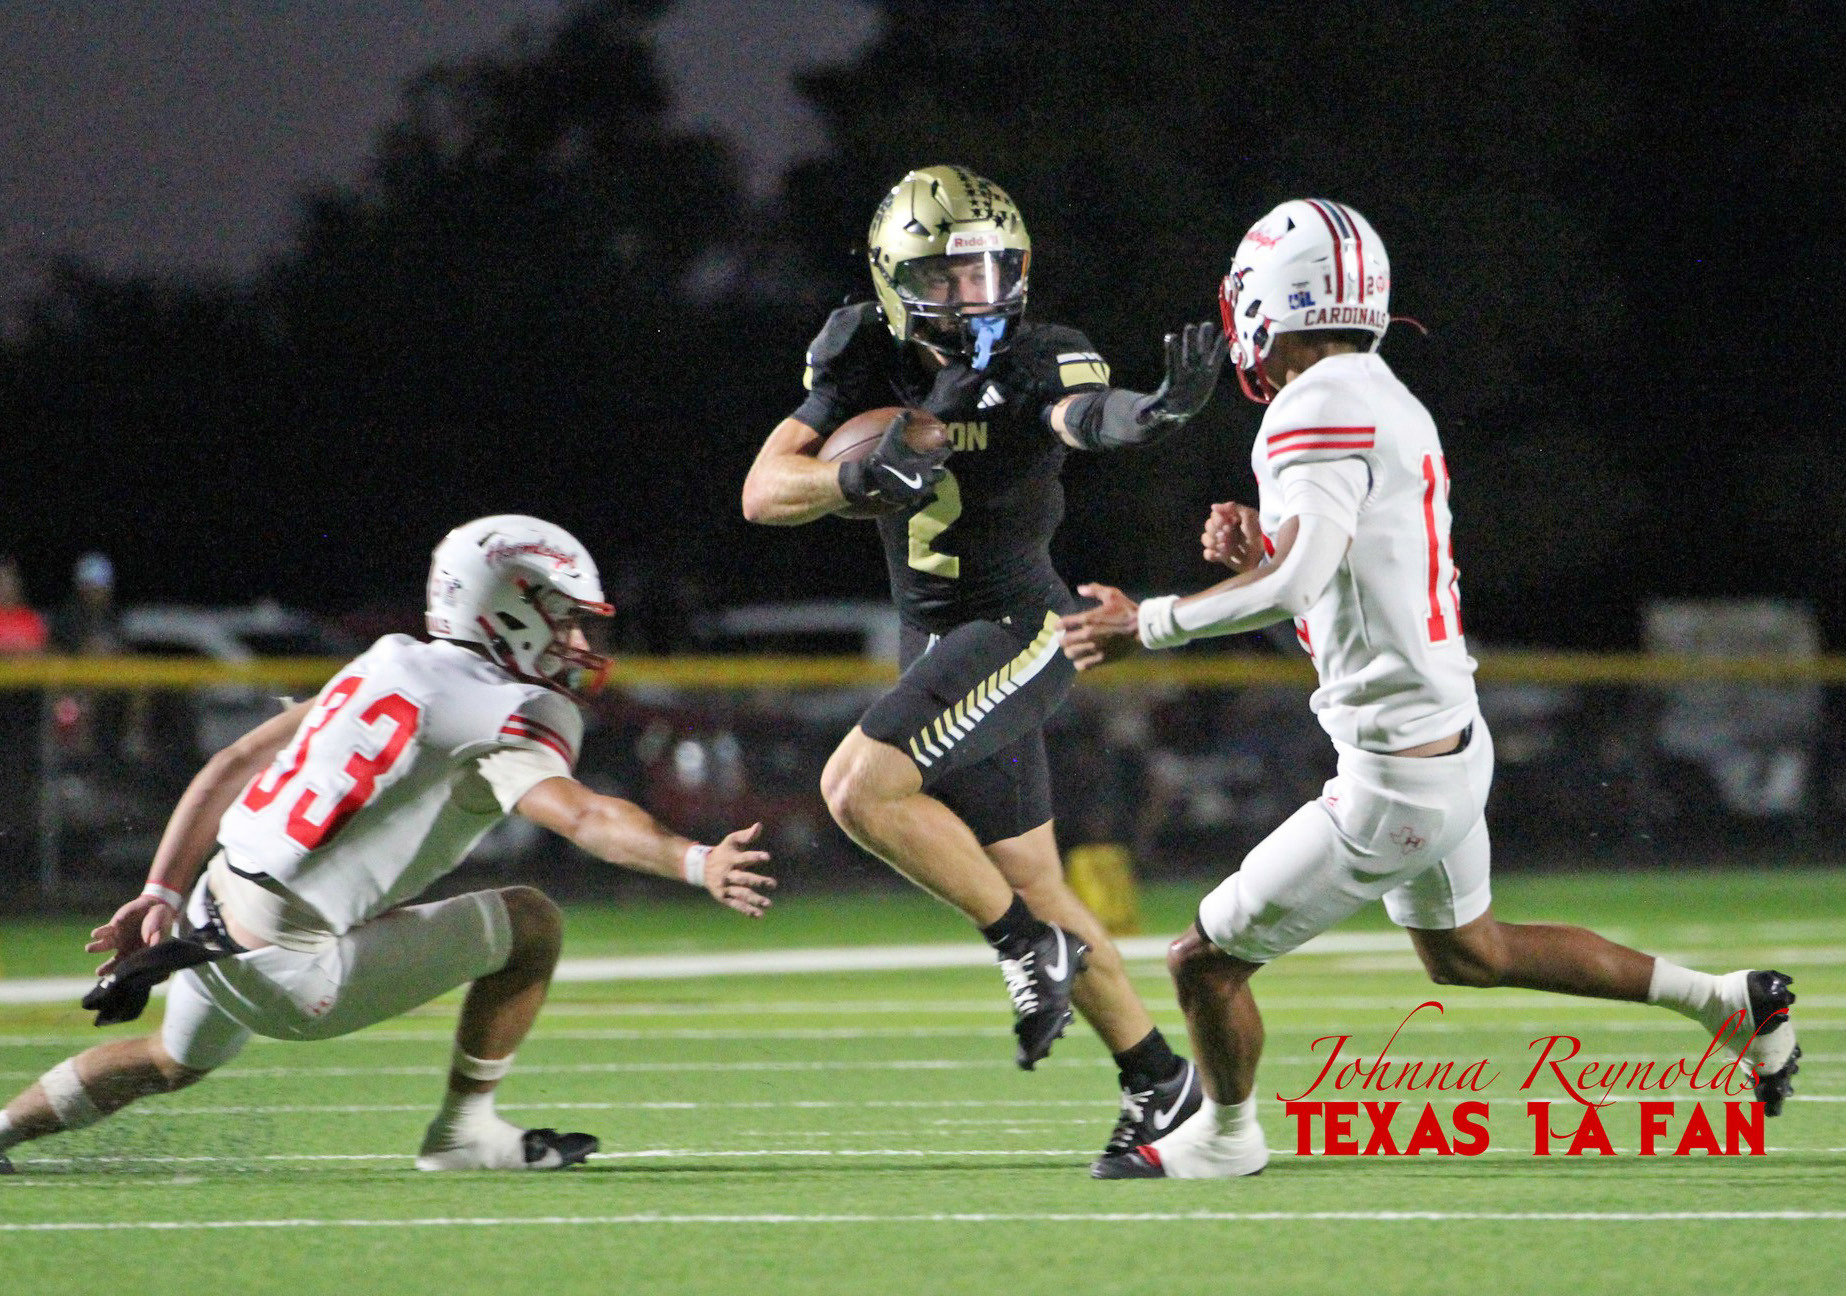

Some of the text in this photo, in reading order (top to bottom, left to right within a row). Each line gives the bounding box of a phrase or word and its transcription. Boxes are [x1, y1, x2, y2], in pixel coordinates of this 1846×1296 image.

[1324, 274, 1374, 295] 1 2
[1304, 307, 1386, 329] CARDINALS
[908, 467, 962, 578] 2
[242, 676, 420, 850] 33
